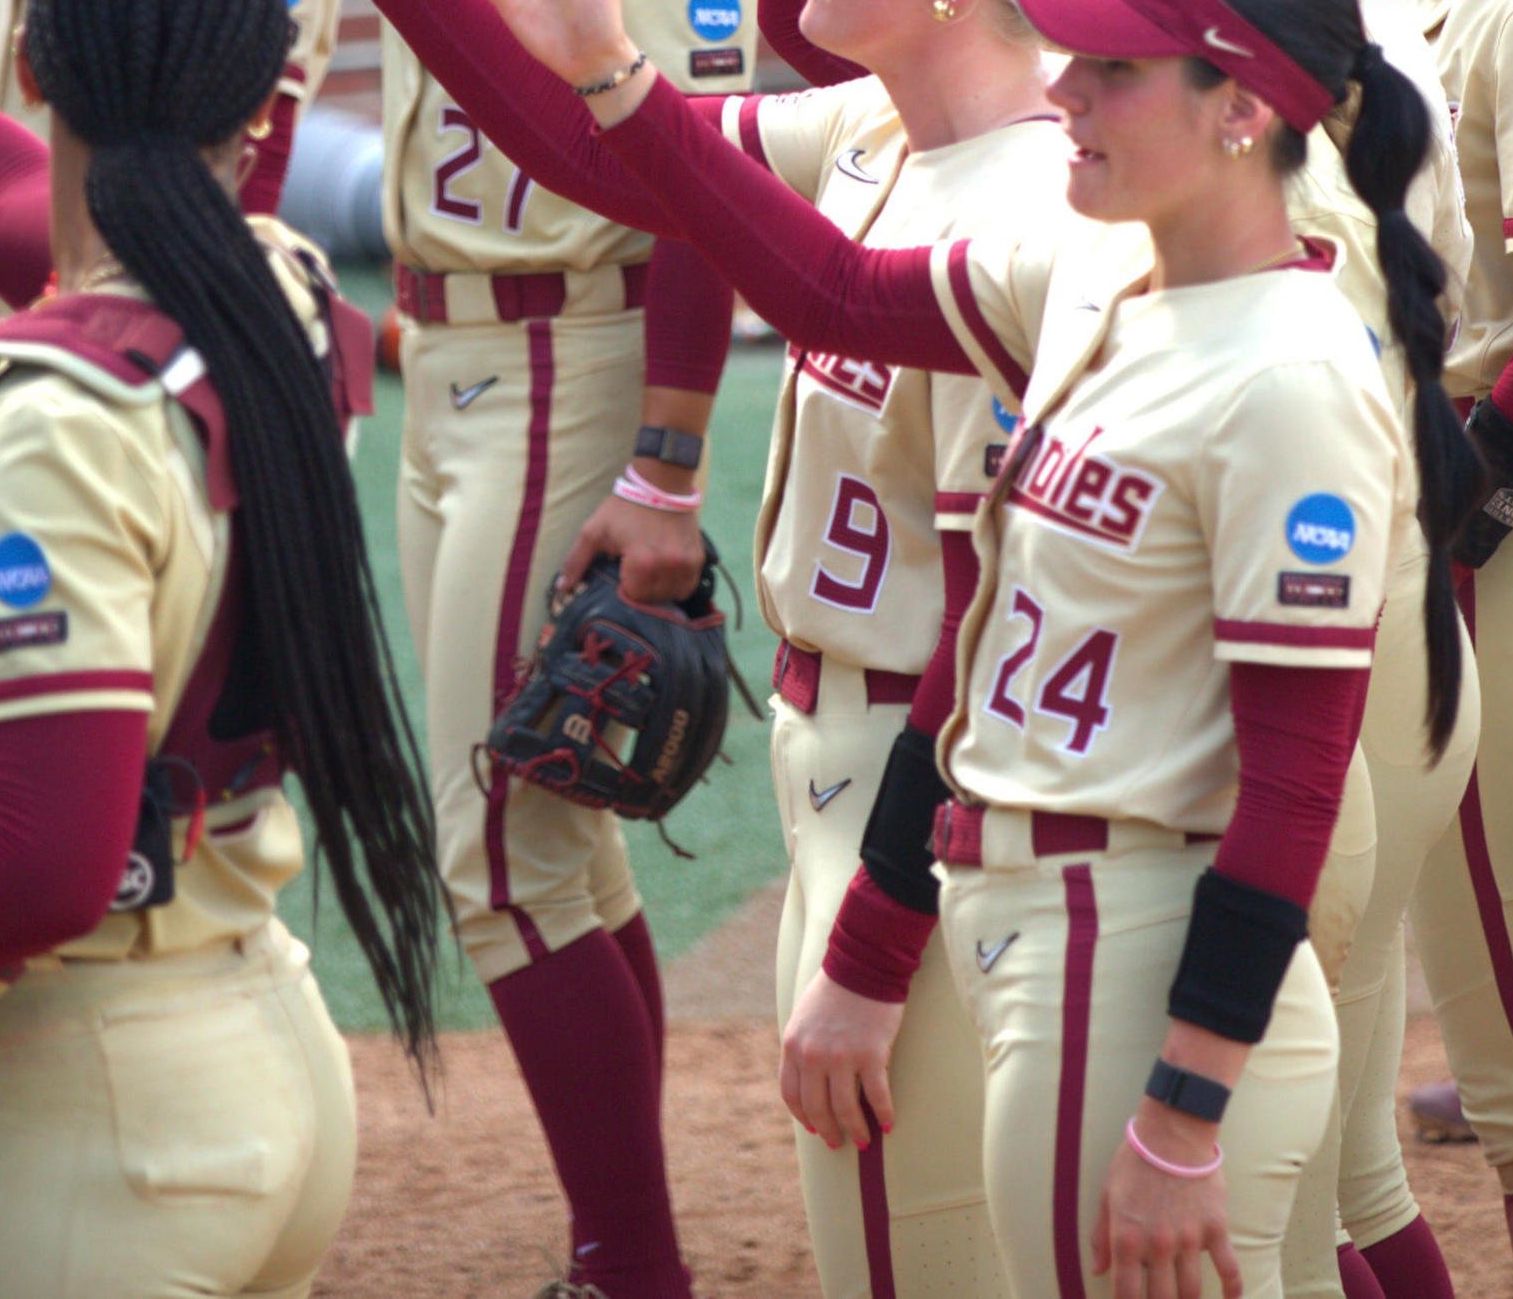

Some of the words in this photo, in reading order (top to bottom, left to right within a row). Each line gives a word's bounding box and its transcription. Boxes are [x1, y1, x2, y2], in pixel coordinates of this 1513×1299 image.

[809, 472, 891, 615] 9
[1293, 522, 1351, 551] NCAA
[983, 583, 1119, 757] 24
